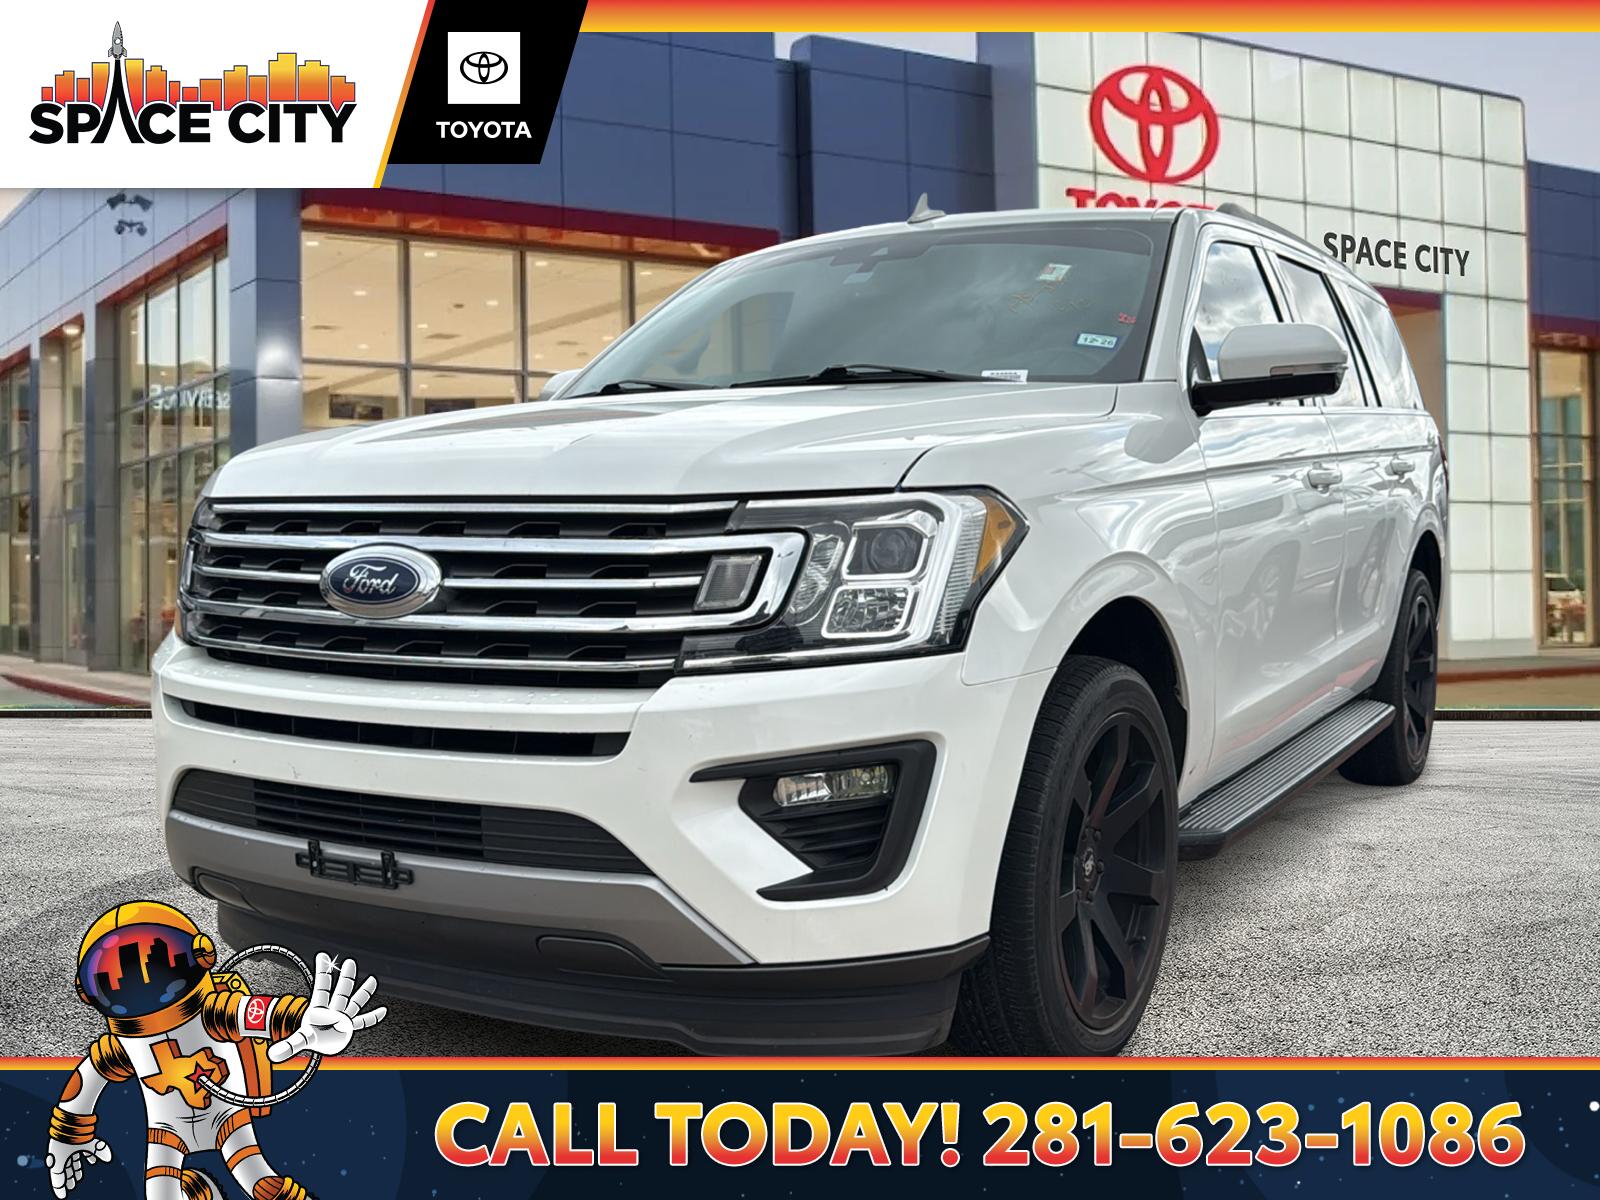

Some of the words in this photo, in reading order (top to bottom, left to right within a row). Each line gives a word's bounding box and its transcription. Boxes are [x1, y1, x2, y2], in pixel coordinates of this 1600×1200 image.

[1323, 231, 1407, 270] SPACE
[1414, 243, 1470, 277] CITY
[342, 563, 399, 594] Ford
